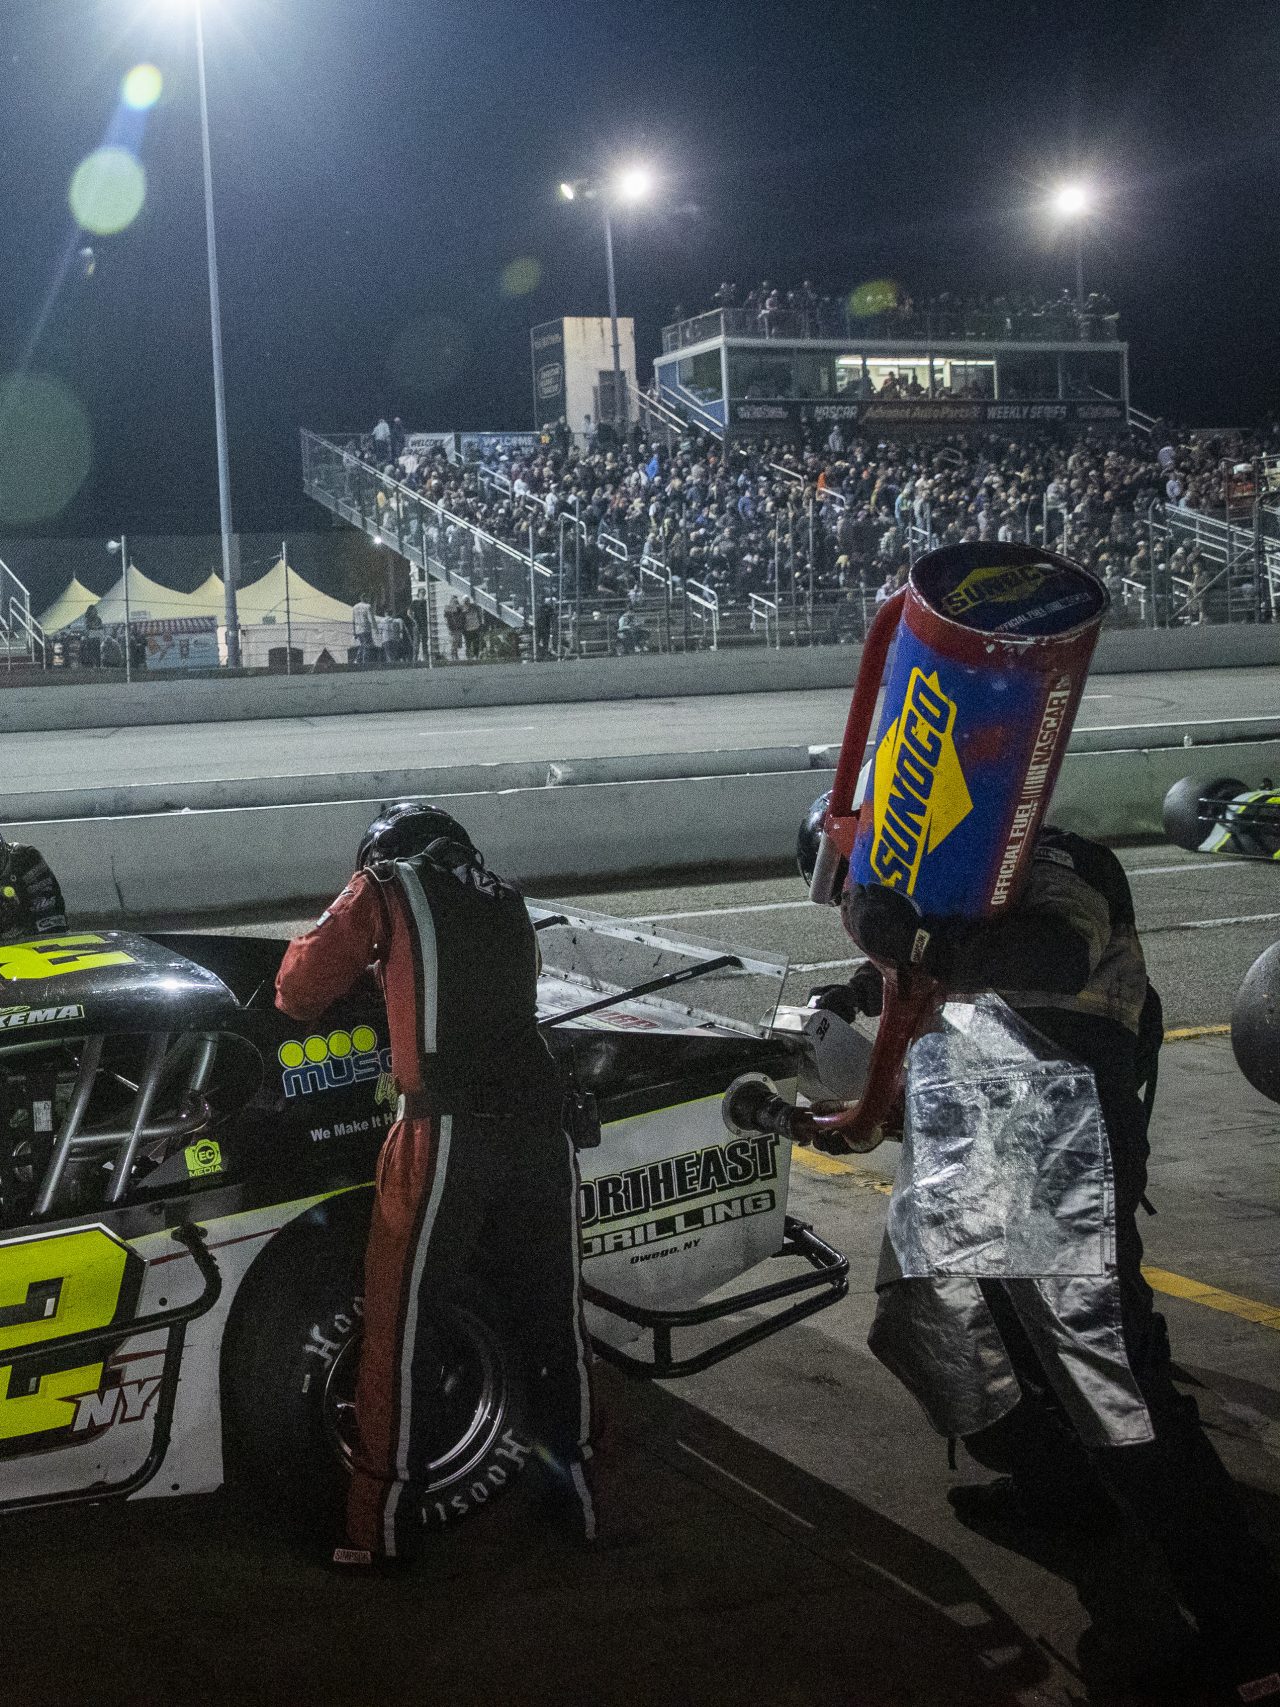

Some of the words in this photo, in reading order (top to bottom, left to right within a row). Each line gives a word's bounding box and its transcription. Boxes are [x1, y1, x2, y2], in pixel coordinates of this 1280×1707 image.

[872, 674, 953, 892] SUNOCO
[991, 849, 1021, 905] OFFICIAL
[1010, 801, 1034, 848] FUEL
[1032, 691, 1070, 769] NASCAR
[816, 1017, 830, 1042] 32
[310, 1128, 333, 1142] We
[334, 1121, 369, 1137] Make
[370, 1117, 382, 1129] It
[188, 1164, 223, 1177] MEDIA
[198, 1150, 214, 1160] EC
[580, 1133, 778, 1226] ORTHEAST
[683, 1238, 701, 1251] NY
[73, 1380, 161, 1431] NY
[422, 1428, 533, 1525] Hoosi
